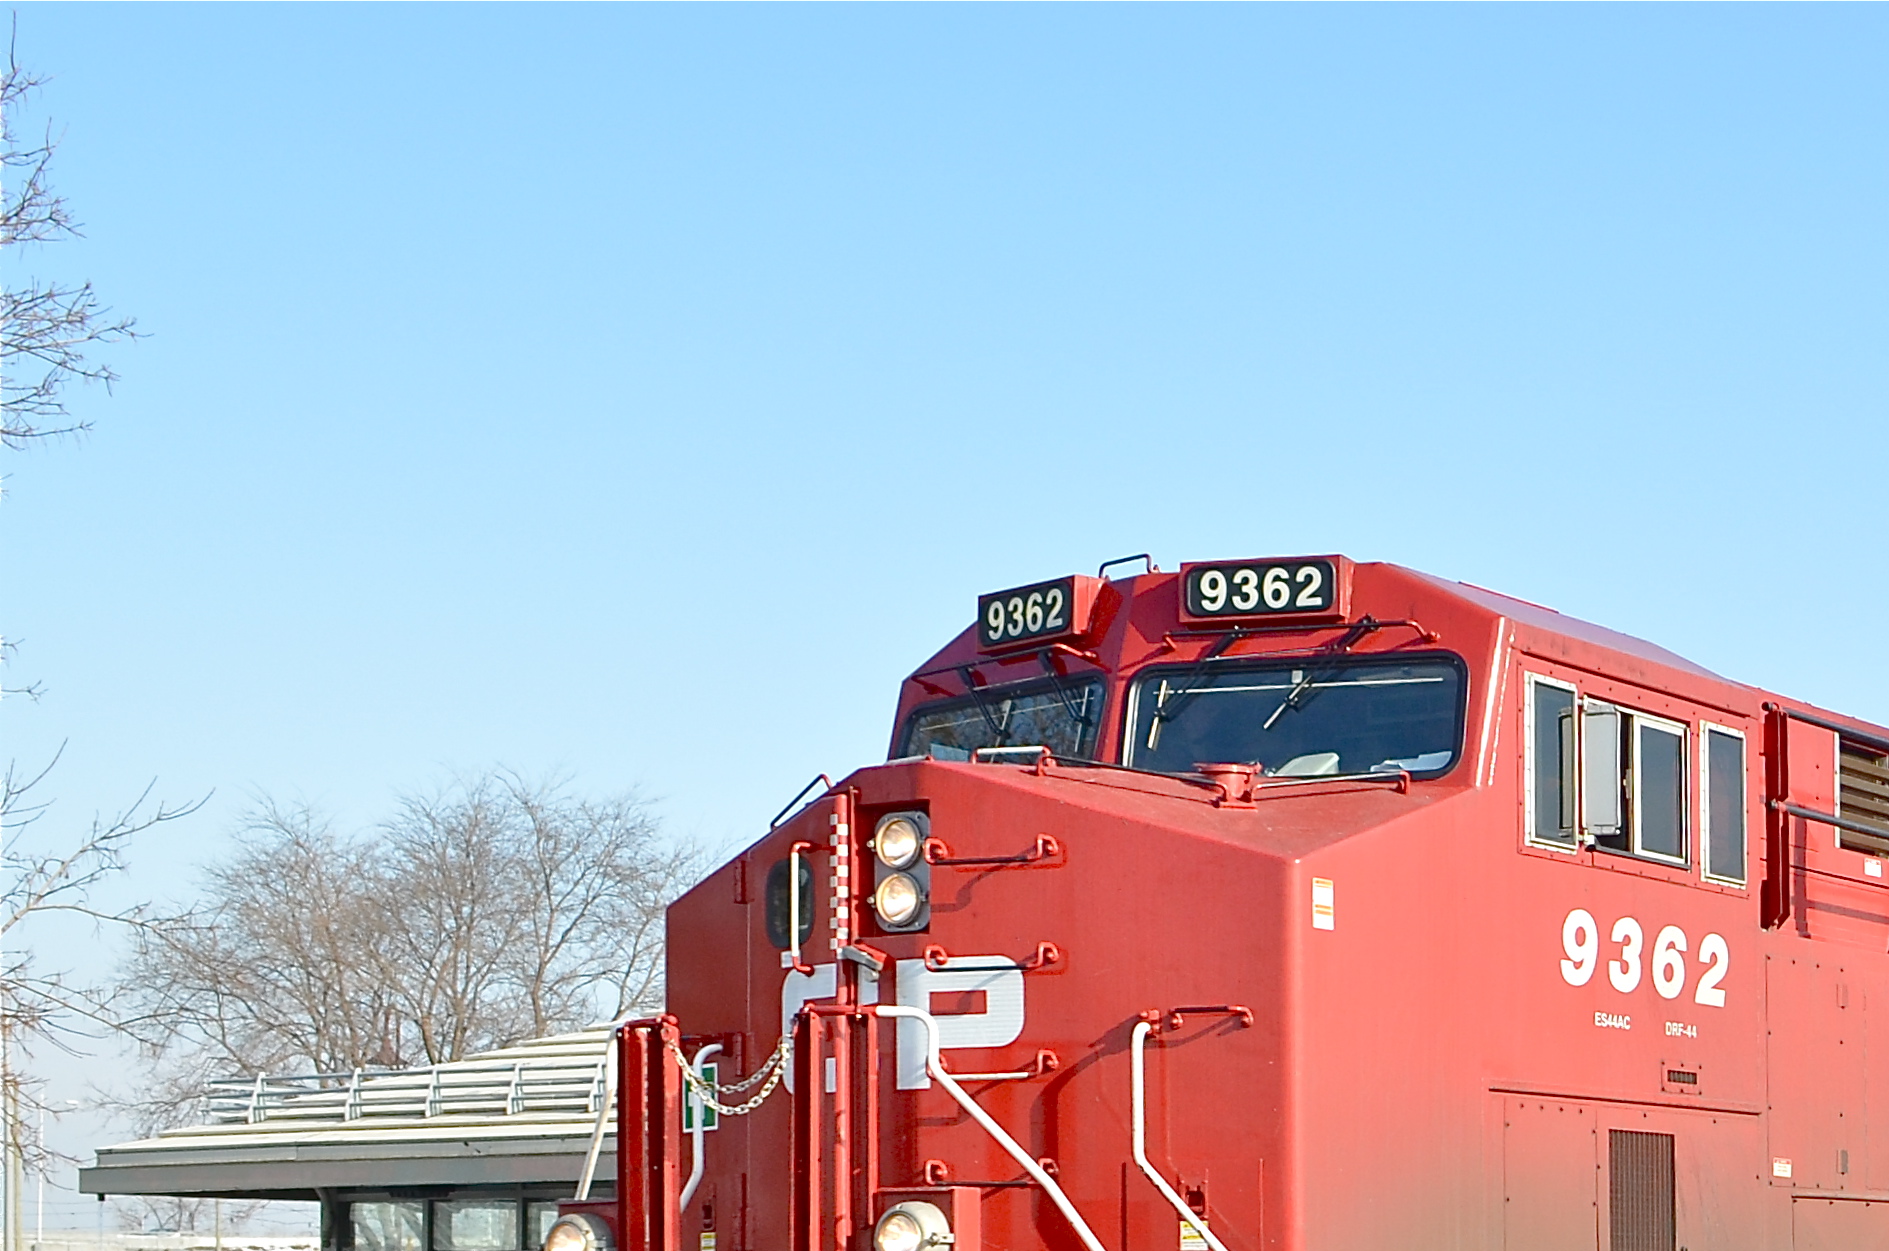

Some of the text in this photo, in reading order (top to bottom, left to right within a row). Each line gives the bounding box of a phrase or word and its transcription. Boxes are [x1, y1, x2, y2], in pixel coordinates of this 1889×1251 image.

[1200, 565, 1323, 612] 9362
[987, 587, 1064, 641] 9362
[1559, 908, 1730, 1008] 9362
[1594, 1011, 1697, 1038] ES44AC DRF-44
